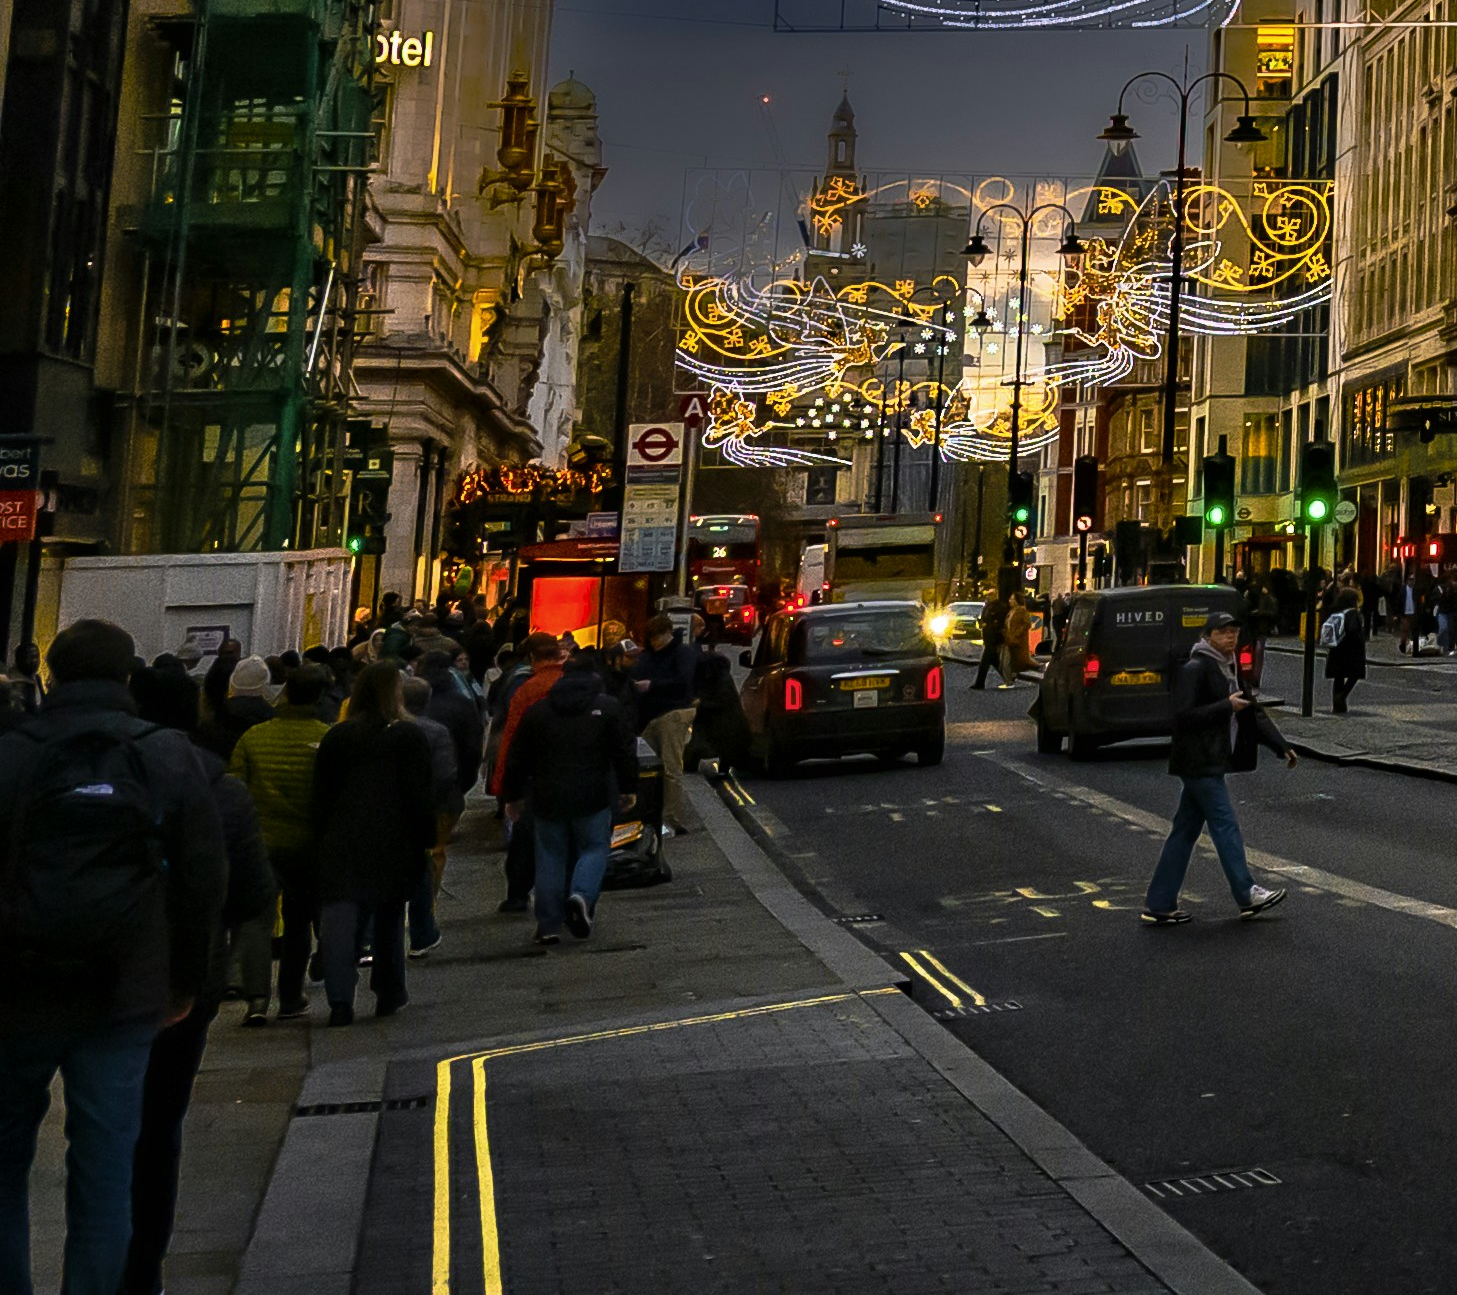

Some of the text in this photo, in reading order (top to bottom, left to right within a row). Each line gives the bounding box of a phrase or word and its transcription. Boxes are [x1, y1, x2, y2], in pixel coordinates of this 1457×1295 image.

[684, 397, 704, 418] A
[0, 515, 27, 529] ICE
[713, 546, 727, 559] 26
